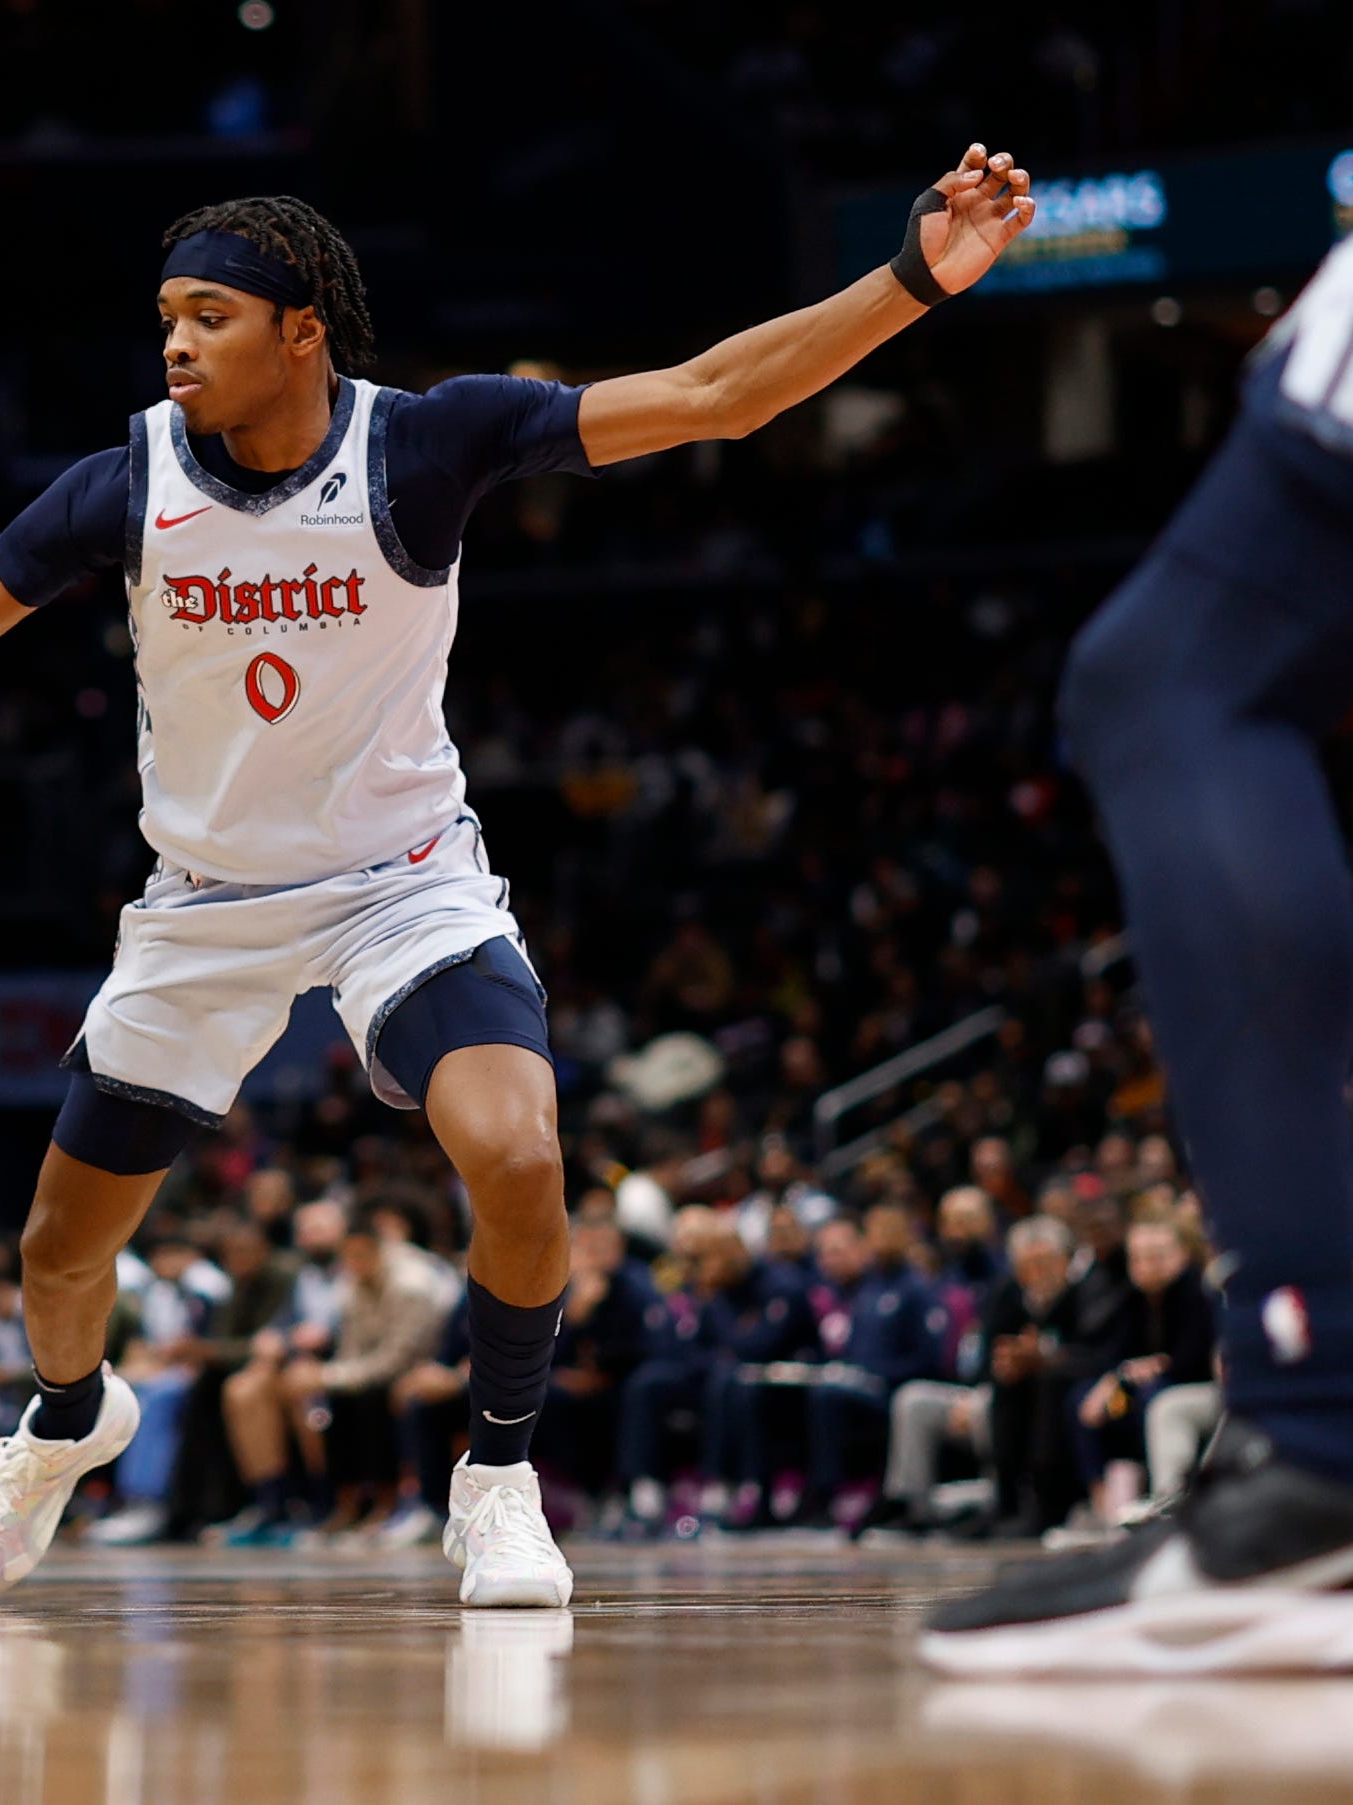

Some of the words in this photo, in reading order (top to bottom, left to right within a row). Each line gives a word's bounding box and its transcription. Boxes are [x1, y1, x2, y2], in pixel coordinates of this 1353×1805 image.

[300, 512, 364, 526] Robinhood
[160, 589, 199, 610] the
[163, 563, 368, 624] District
[227, 618, 361, 636] COLUMBIA
[245, 651, 301, 725] 0
